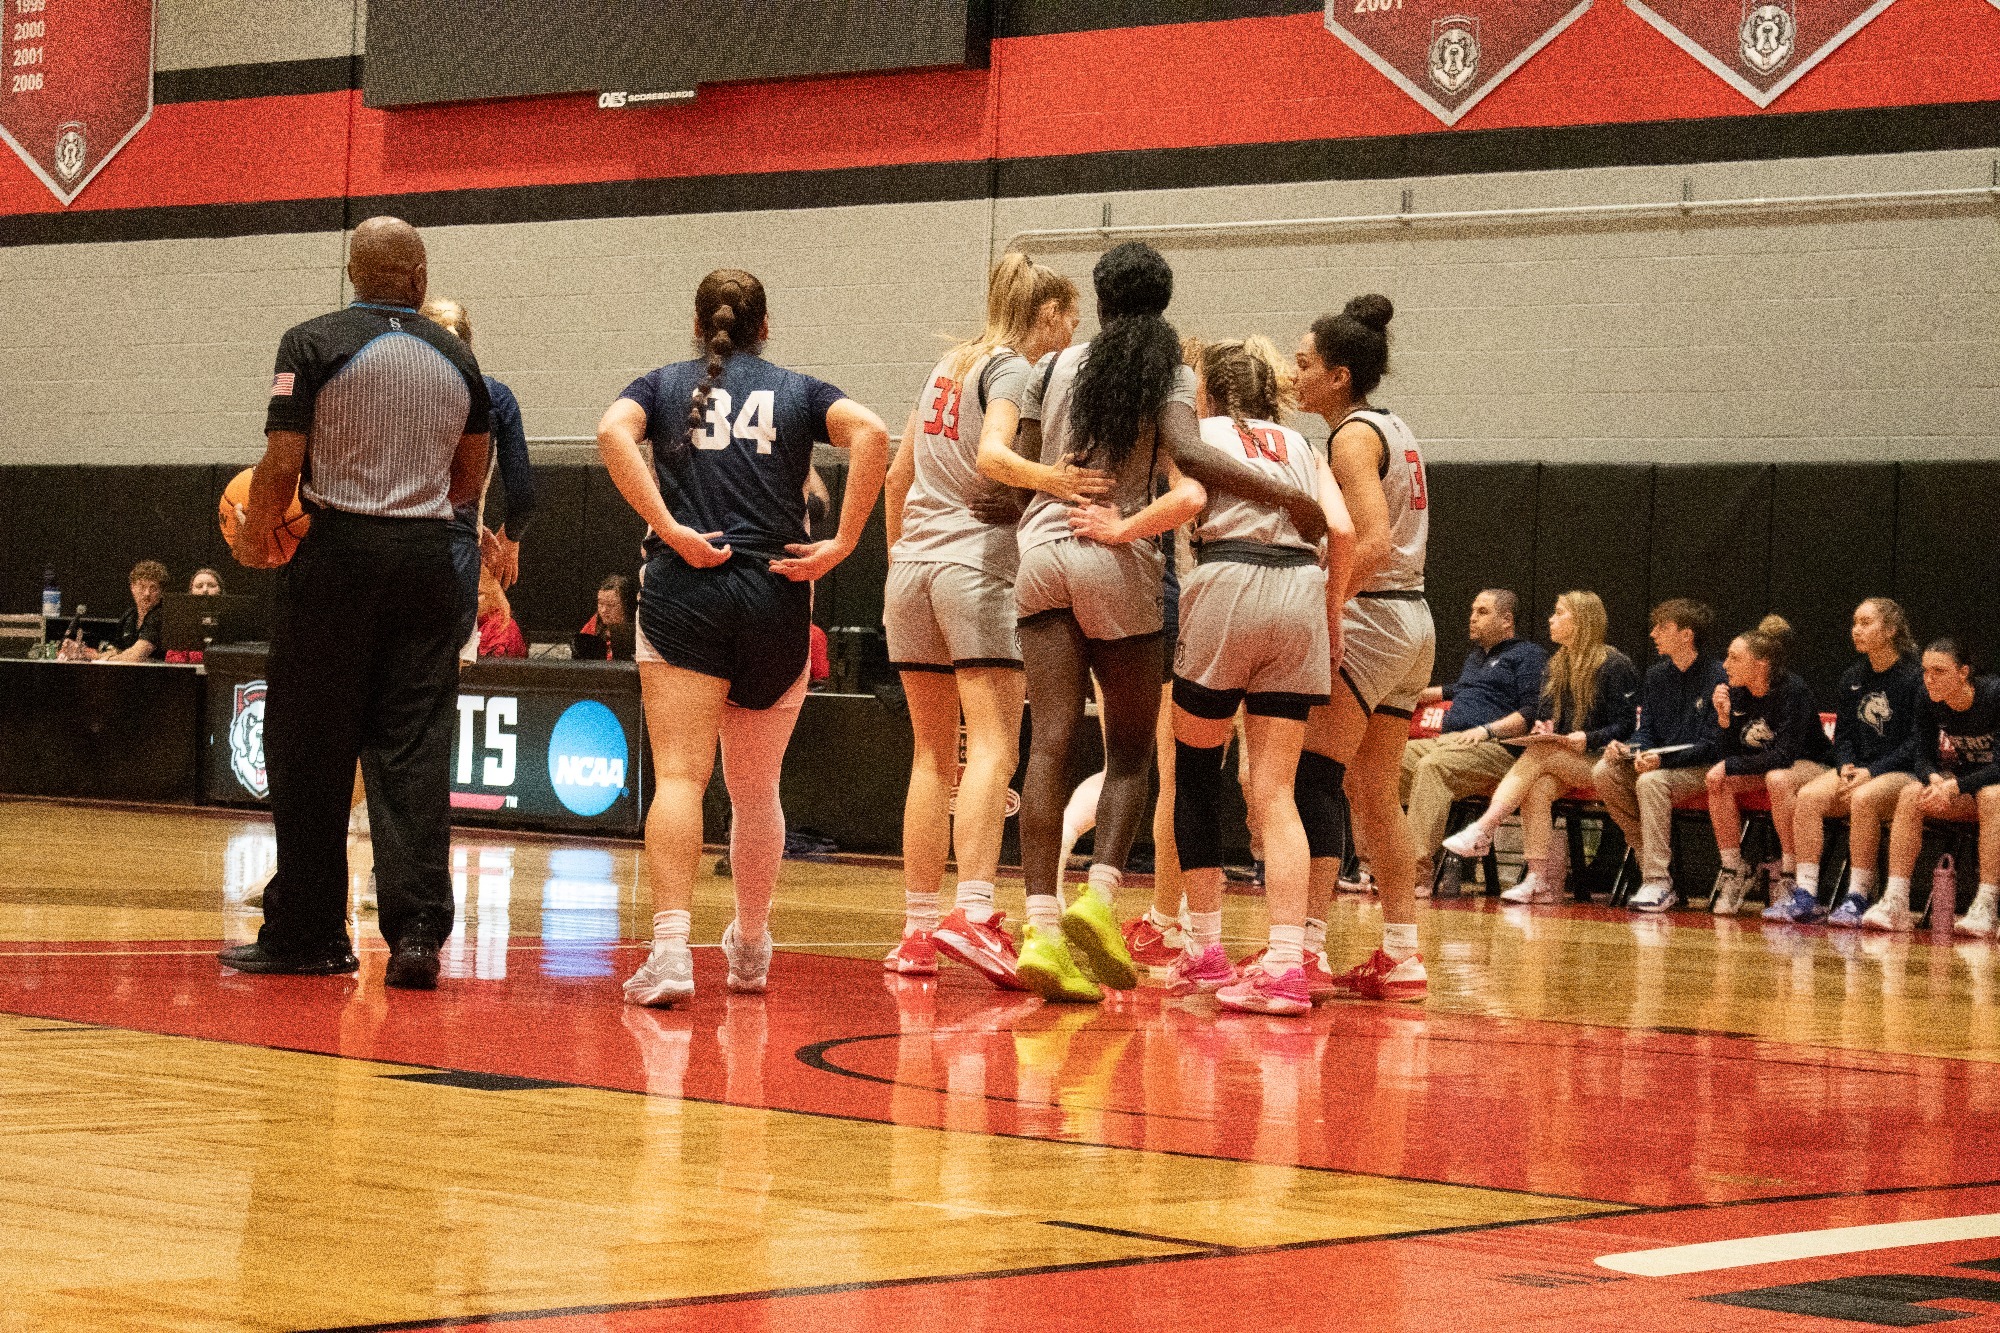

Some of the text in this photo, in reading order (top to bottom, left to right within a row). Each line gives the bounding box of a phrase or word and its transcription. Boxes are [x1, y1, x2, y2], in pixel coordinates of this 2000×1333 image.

[14, 20, 45, 40] 2000
[13, 47, 43, 66] 2001
[12, 73, 44, 92] 2006
[628, 91, 695, 102] SCOREBOARDS
[691, 387, 777, 455] 34
[924, 376, 963, 441] 33
[1232, 424, 1290, 466] 10
[555, 755, 625, 788] NCAA
